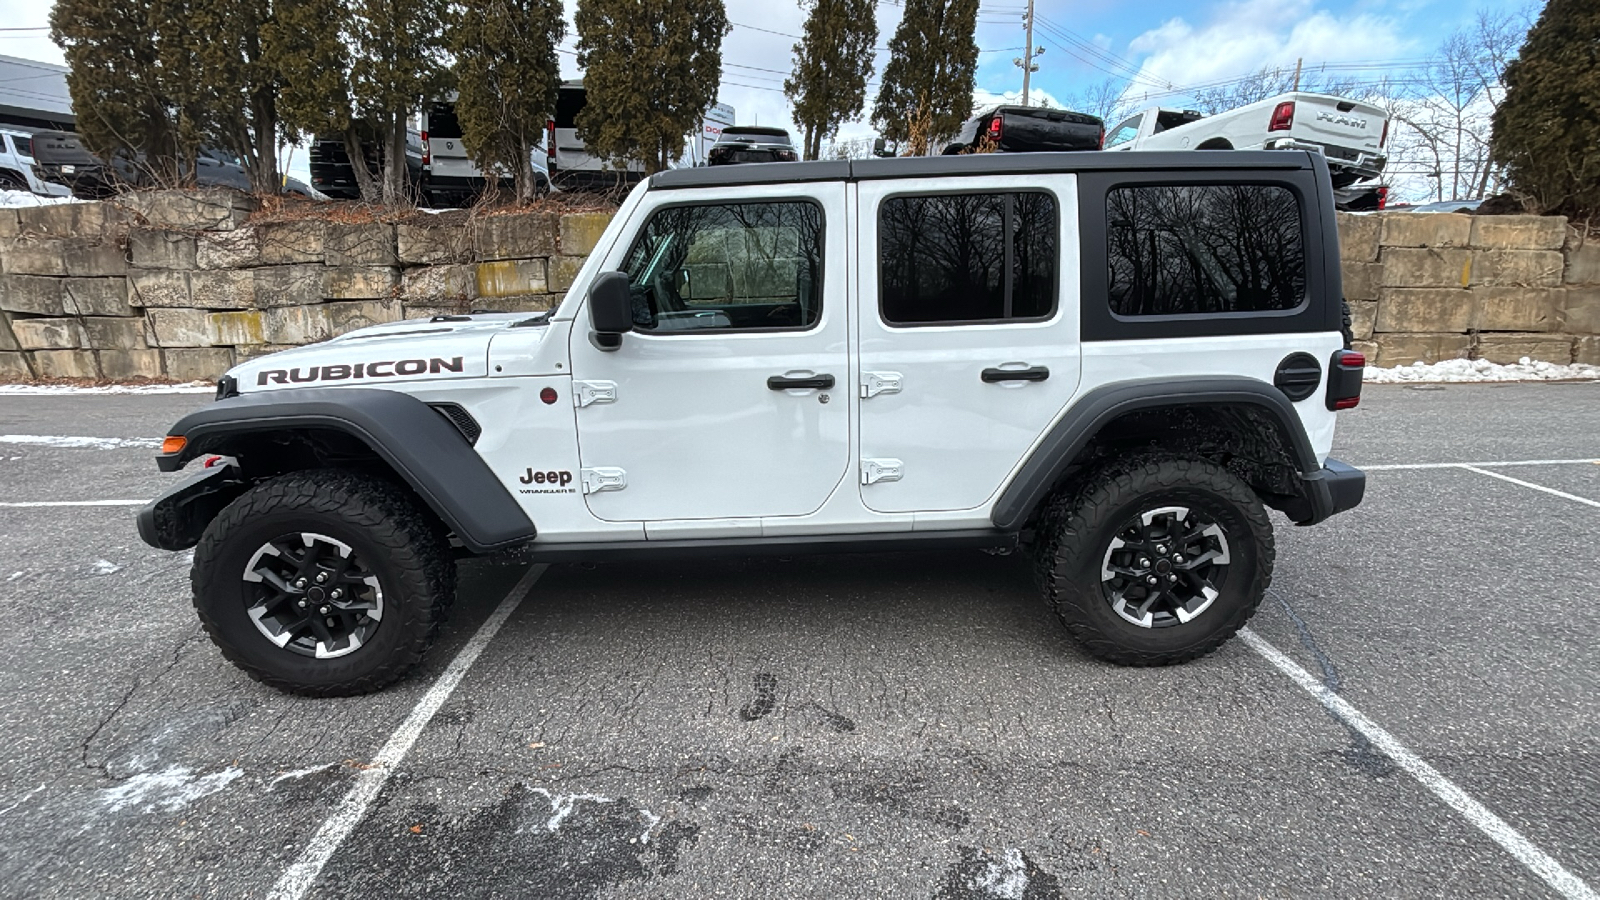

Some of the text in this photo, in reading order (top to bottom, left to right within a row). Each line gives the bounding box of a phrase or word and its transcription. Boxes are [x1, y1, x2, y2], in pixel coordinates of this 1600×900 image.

[1316, 111, 1367, 129] RAM
[257, 356, 463, 386] RUBICON
[519, 467, 572, 487] Jeep
